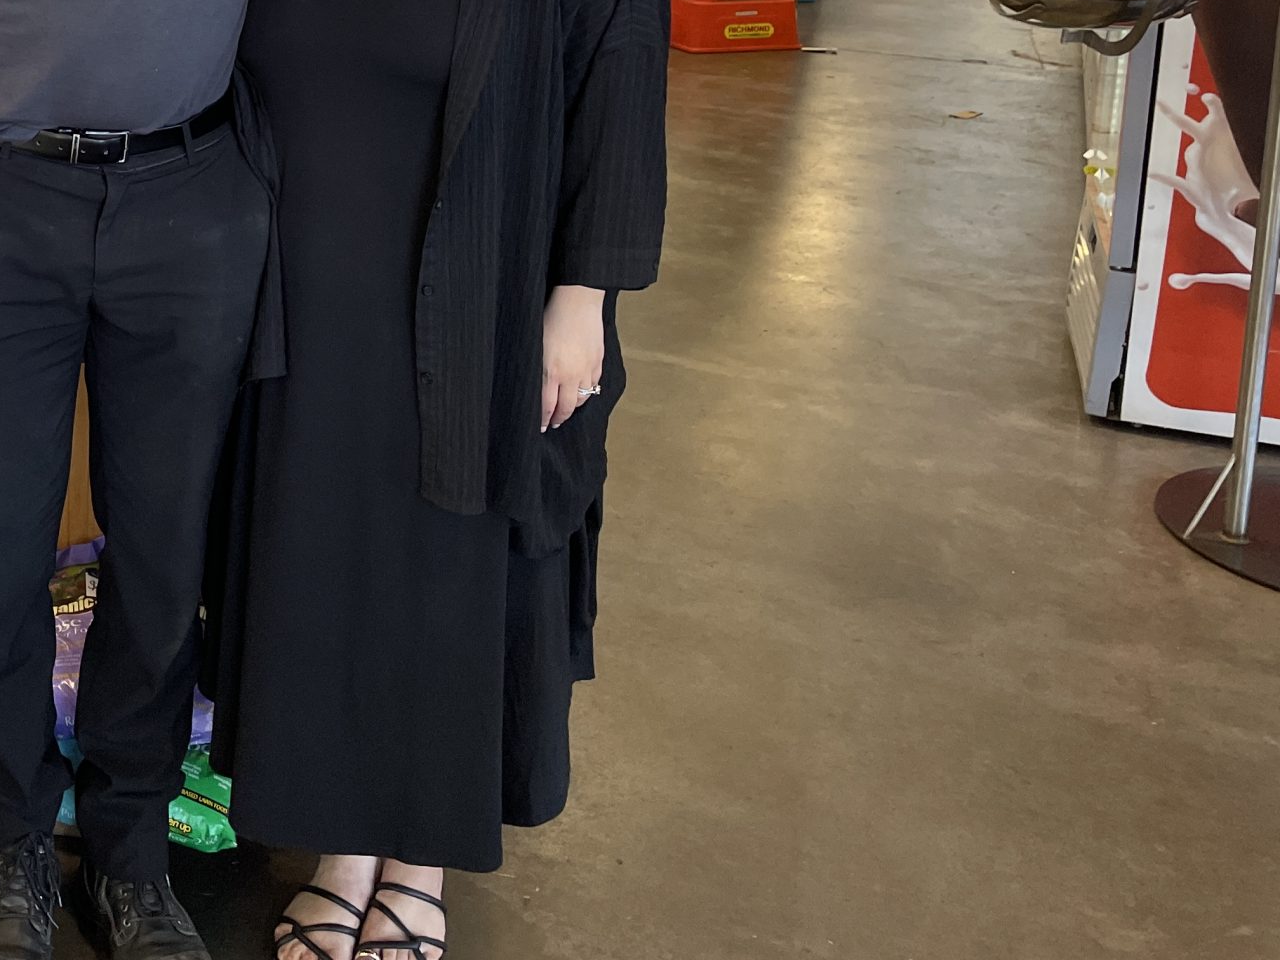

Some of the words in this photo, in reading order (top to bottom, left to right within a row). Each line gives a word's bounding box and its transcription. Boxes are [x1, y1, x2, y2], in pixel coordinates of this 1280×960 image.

[181, 788, 198, 800] BASED
[198, 796, 214, 807] LAWN
[214, 802, 228, 814] FOOD
[180, 822, 192, 834] up
